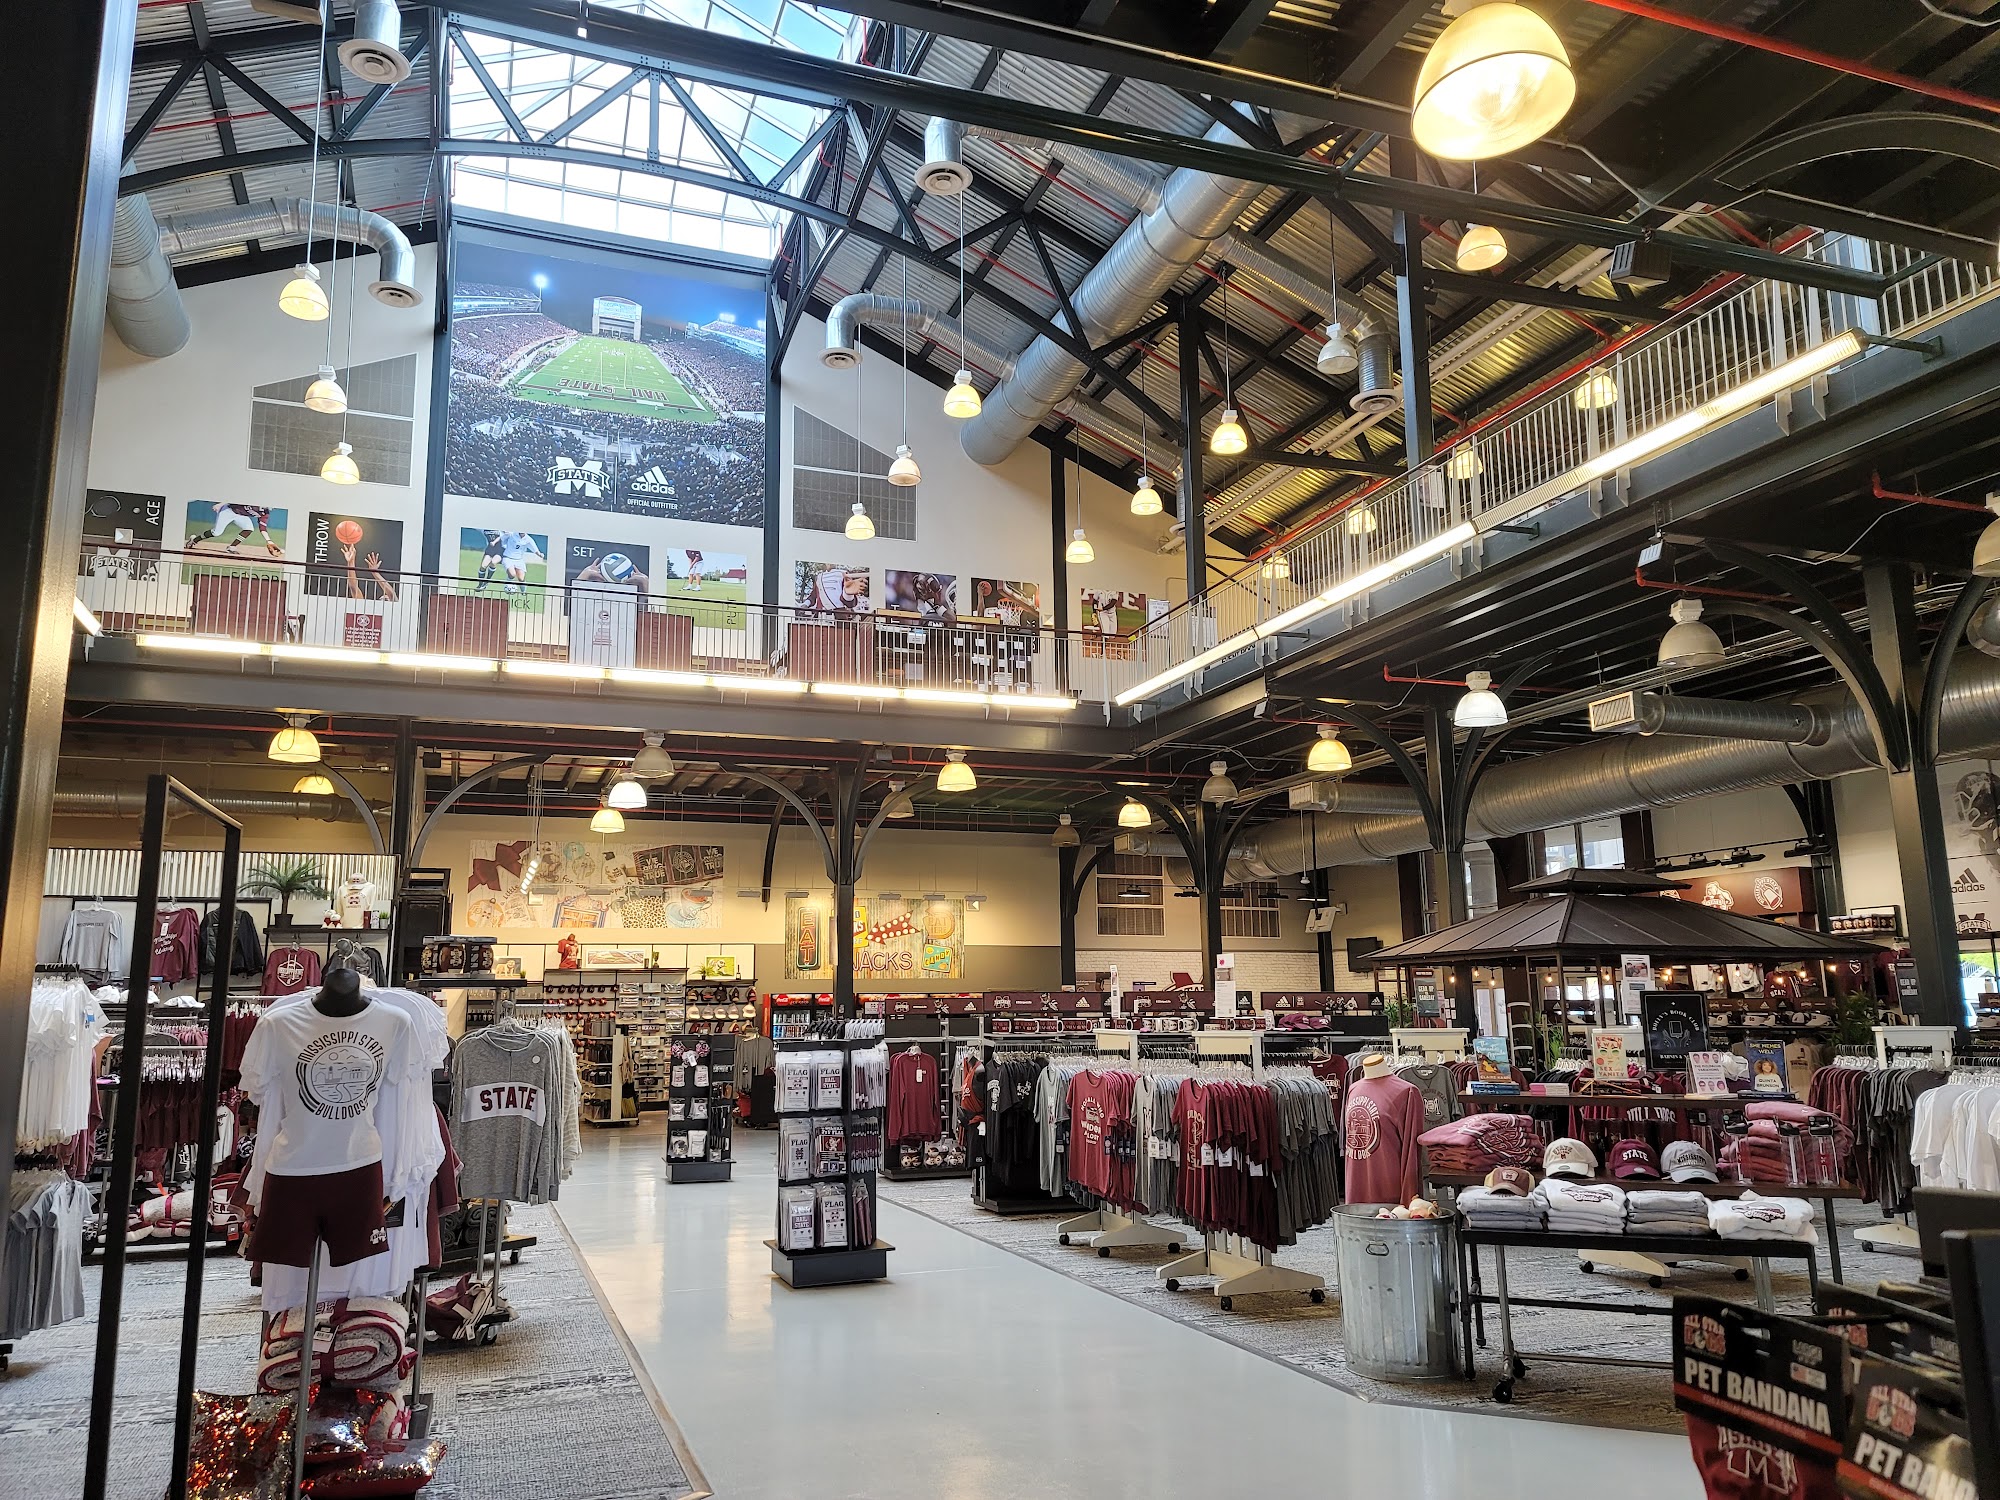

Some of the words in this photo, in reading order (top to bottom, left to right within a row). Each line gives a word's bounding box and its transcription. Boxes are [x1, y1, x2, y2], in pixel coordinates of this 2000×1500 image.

[557, 469, 600, 483] STATE
[630, 481, 676, 495] adidas
[627, 498, 650, 508] OFFICIAL
[651, 500, 678, 510] OUTFITTER
[145, 500, 161, 526] ACE
[314, 518, 330, 563] THROW
[572, 545, 595, 558] SET
[511, 597, 531, 610] ICK
[644, 870, 666, 880] TRUE
[1951, 882, 1986, 894] adidas
[927, 917, 947, 926] EAT
[1960, 920, 1986, 930] STATE
[928, 925, 948, 933] HERE
[800, 911, 815, 963] EAT
[853, 950, 913, 972] ACKS
[924, 949, 951, 966] CANDY
[297, 1030, 359, 1063] MISSISSIPPI
[358, 1034, 384, 1061] STATE
[479, 1085, 538, 1112] STATE
[315, 1099, 367, 1120] BULLDOGS
[791, 1139, 808, 1147] FLAG
[1622, 1149, 1649, 1162] STATE
[825, 1200, 844, 1208] FLAG
[1684, 1356, 1722, 1394] PET
[1726, 1369, 1832, 1436] BANDANA
[1853, 1431, 1903, 1479] PET
[1899, 1452, 1979, 1500] BAND
